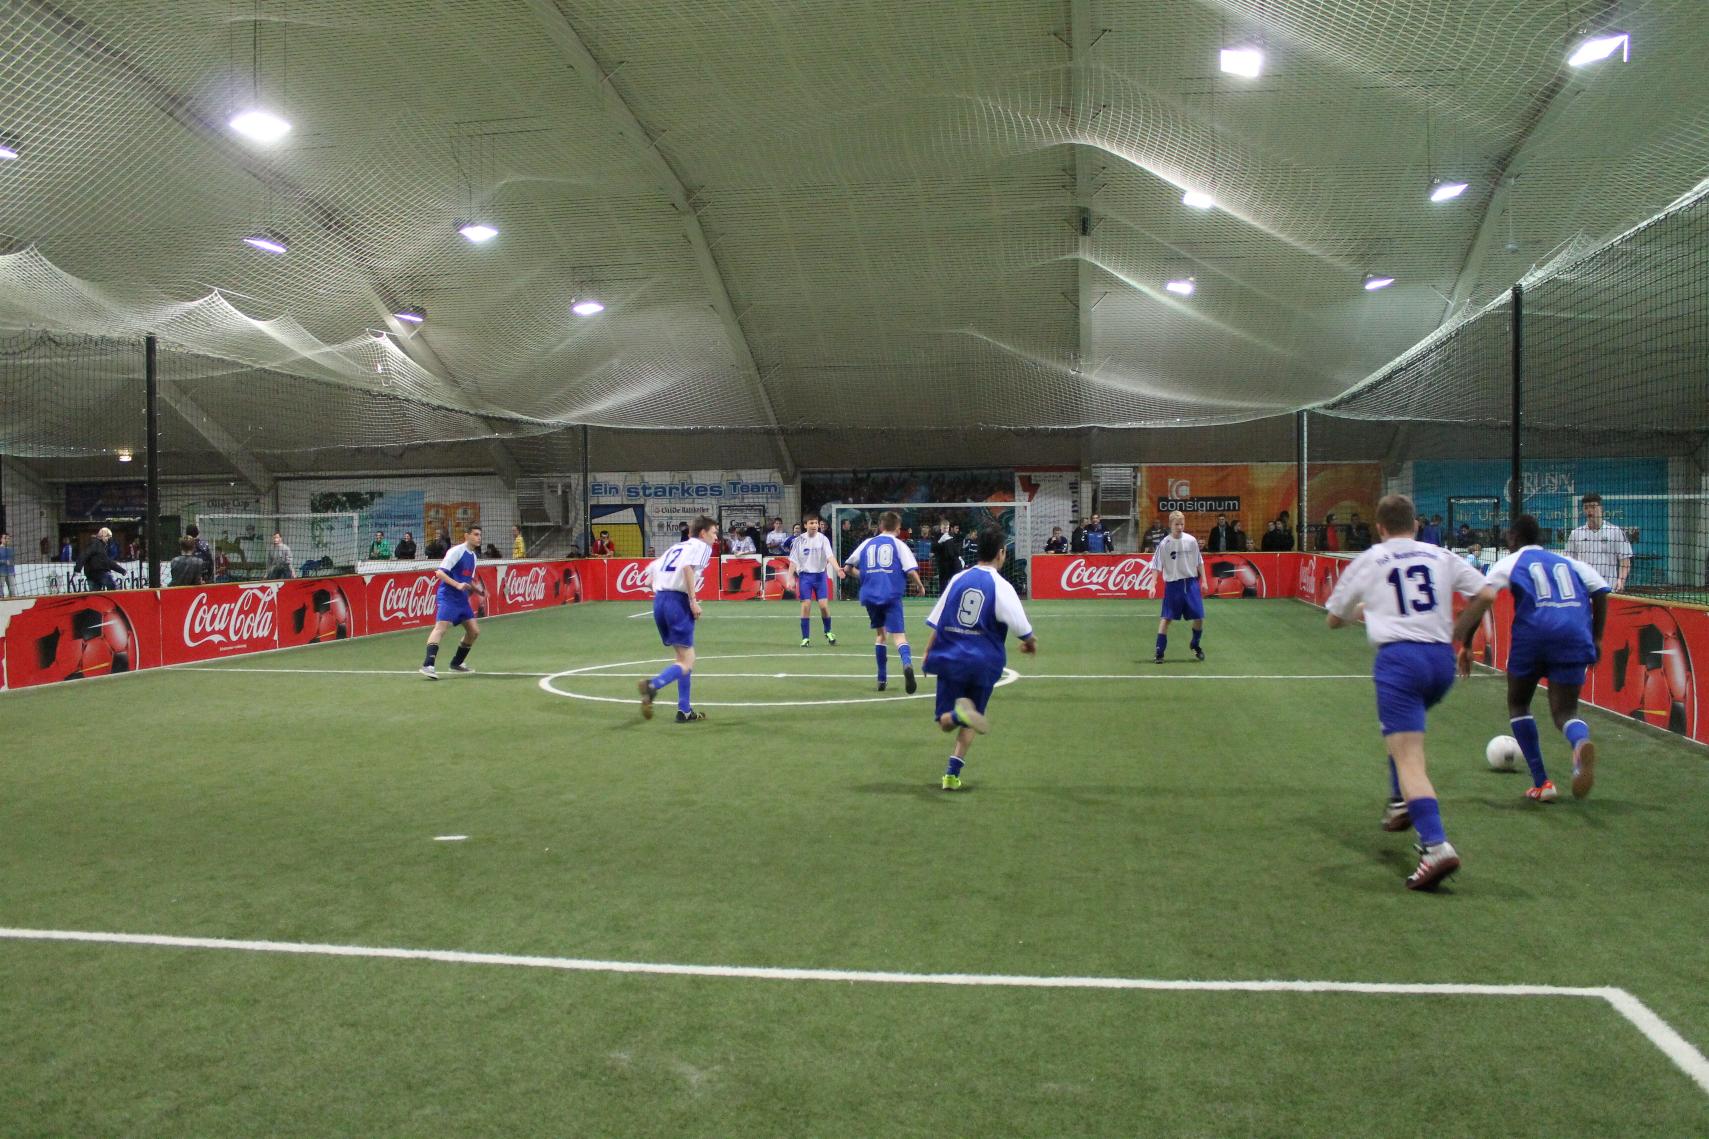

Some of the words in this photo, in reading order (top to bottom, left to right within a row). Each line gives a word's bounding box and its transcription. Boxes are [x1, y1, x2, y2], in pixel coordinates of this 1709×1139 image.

[591, 483, 619, 496] Ein
[626, 482, 724, 498] starkes
[729, 482, 778, 494] Team
[1159, 498, 1239, 512] consignum
[661, 548, 683, 572] 12
[867, 544, 894, 568] 10
[1061, 558, 1152, 591] Coca-Cola
[379, 576, 440, 621] Coca-Cola
[504, 567, 547, 605] Coca-Cola
[1388, 565, 1438, 615] 13
[1528, 562, 1576, 600] 11
[184, 588, 276, 647] Coca-Cola
[957, 588, 985, 628] 9
